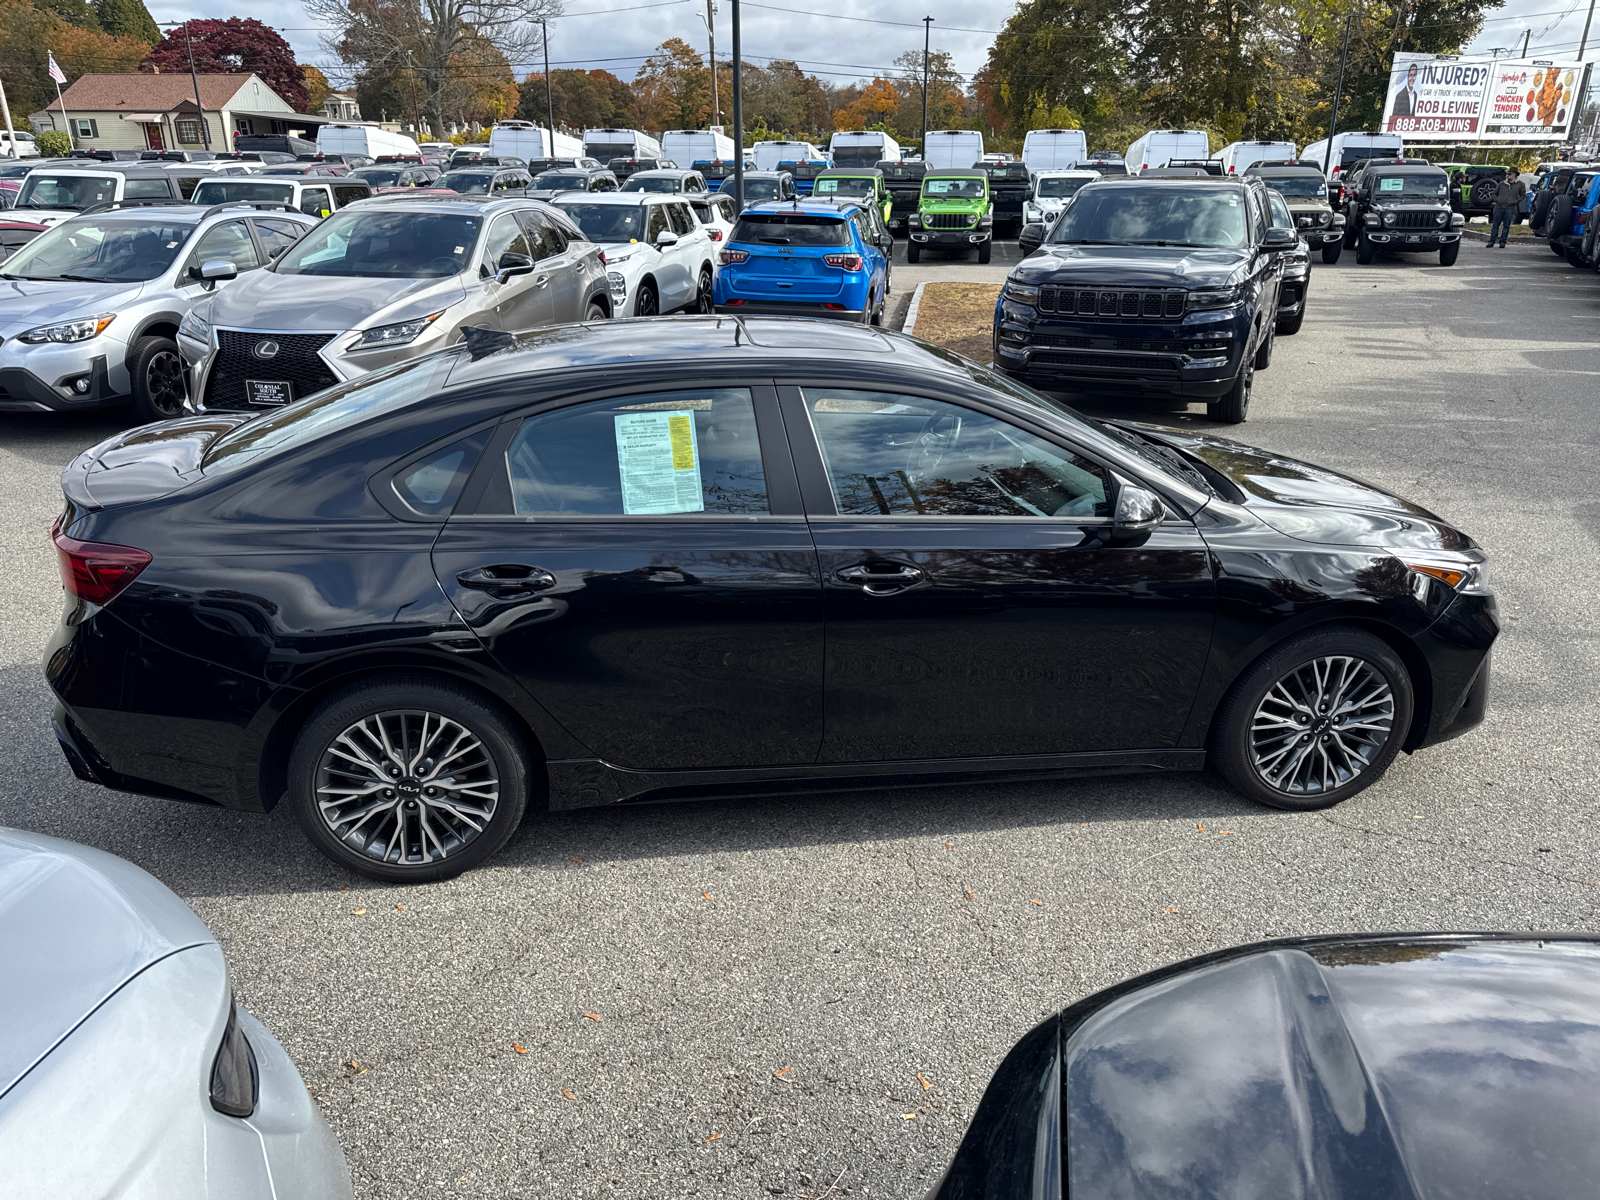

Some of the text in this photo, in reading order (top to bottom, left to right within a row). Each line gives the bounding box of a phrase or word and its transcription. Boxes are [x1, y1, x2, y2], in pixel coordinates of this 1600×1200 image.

[1421, 65, 1487, 86] INJURED?
[1438, 89, 1452, 97] TRUCK
[1495, 95, 1524, 103] CHICKEN
[1416, 100, 1480, 115] ROB LEVINE
[1494, 104, 1521, 112] TENDERS
[1395, 118, 1471, 131] 888-ROB-WINS
[1500, 125, 1510, 133] OPEN
[323, 698, 375, 731] KUMHO
[1369, 743, 1399, 781] KUMHO
